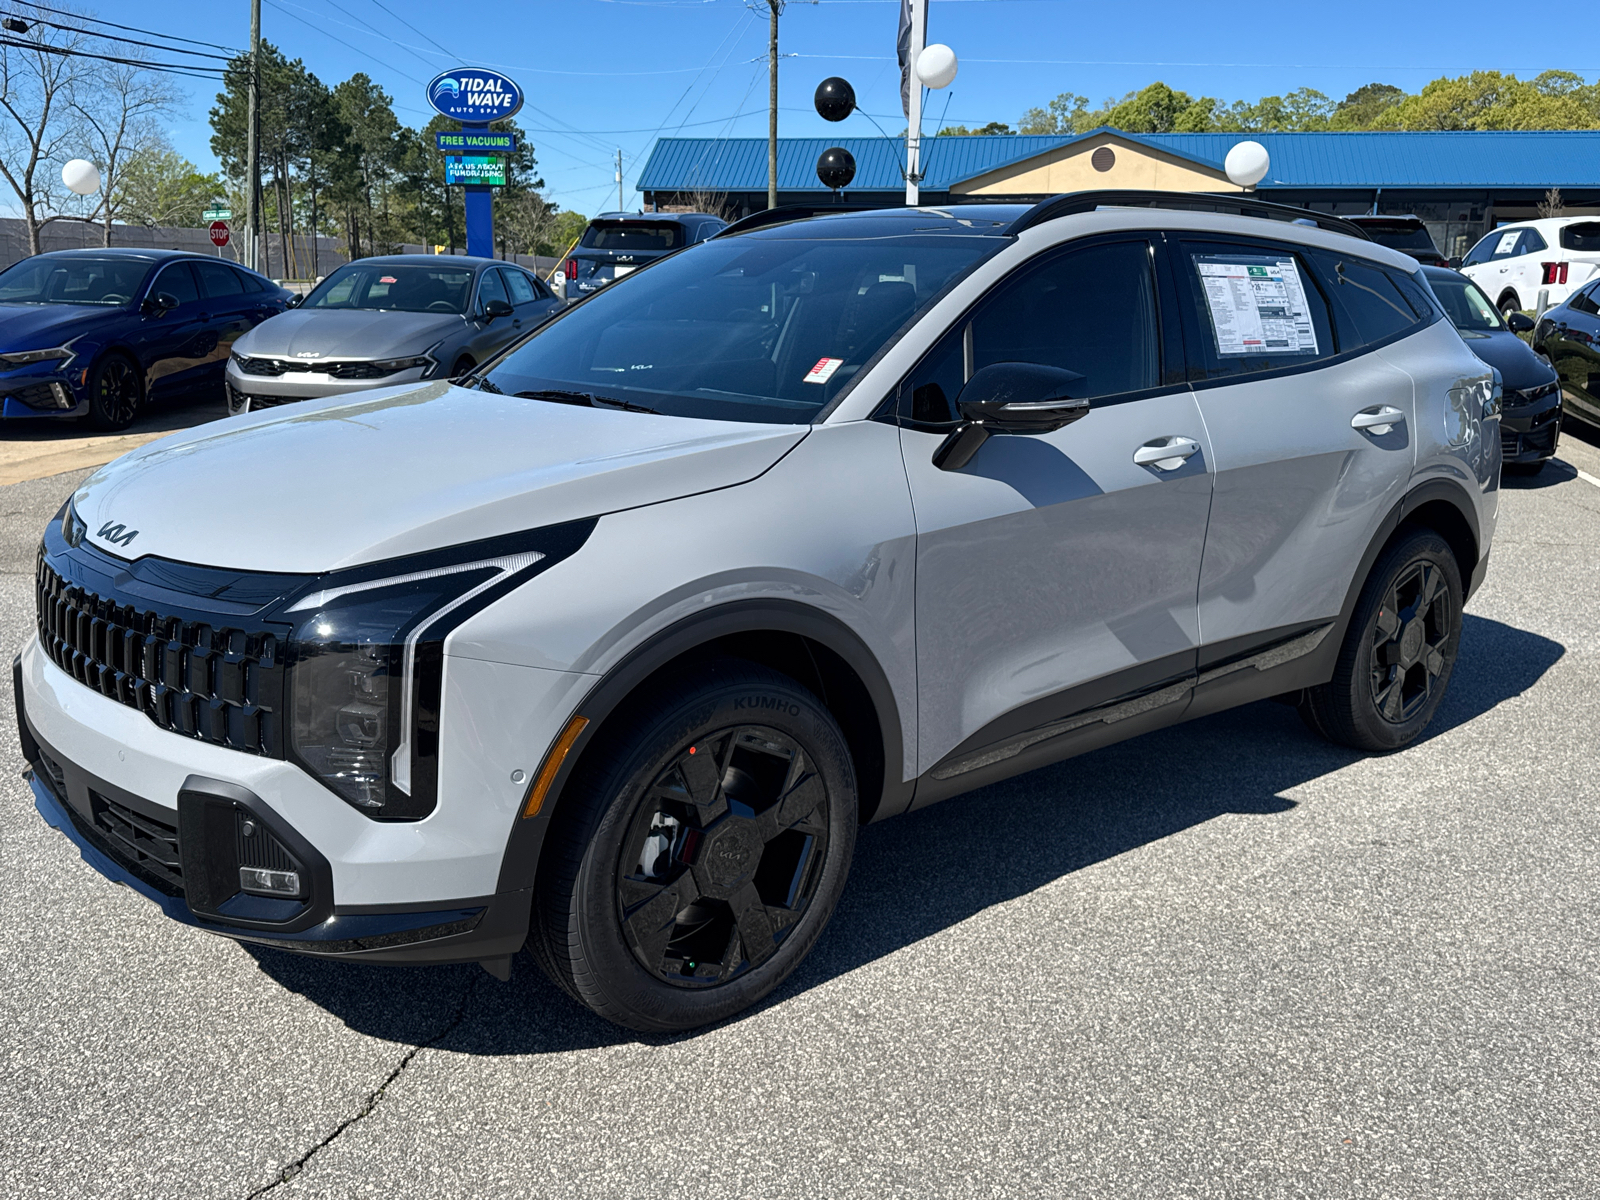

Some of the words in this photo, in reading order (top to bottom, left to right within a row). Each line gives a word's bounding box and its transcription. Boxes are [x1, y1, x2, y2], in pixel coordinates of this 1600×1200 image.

[460, 78, 503, 91] TIDAL
[467, 93, 512, 106] WAVE
[440, 136, 464, 145] FREE
[466, 136, 510, 147] VACUUMS
[450, 169, 503, 177] FUNDRAISING
[210, 228, 228, 239] STOP
[96, 519, 139, 548] KIA
[733, 695, 801, 717] KUMHO
